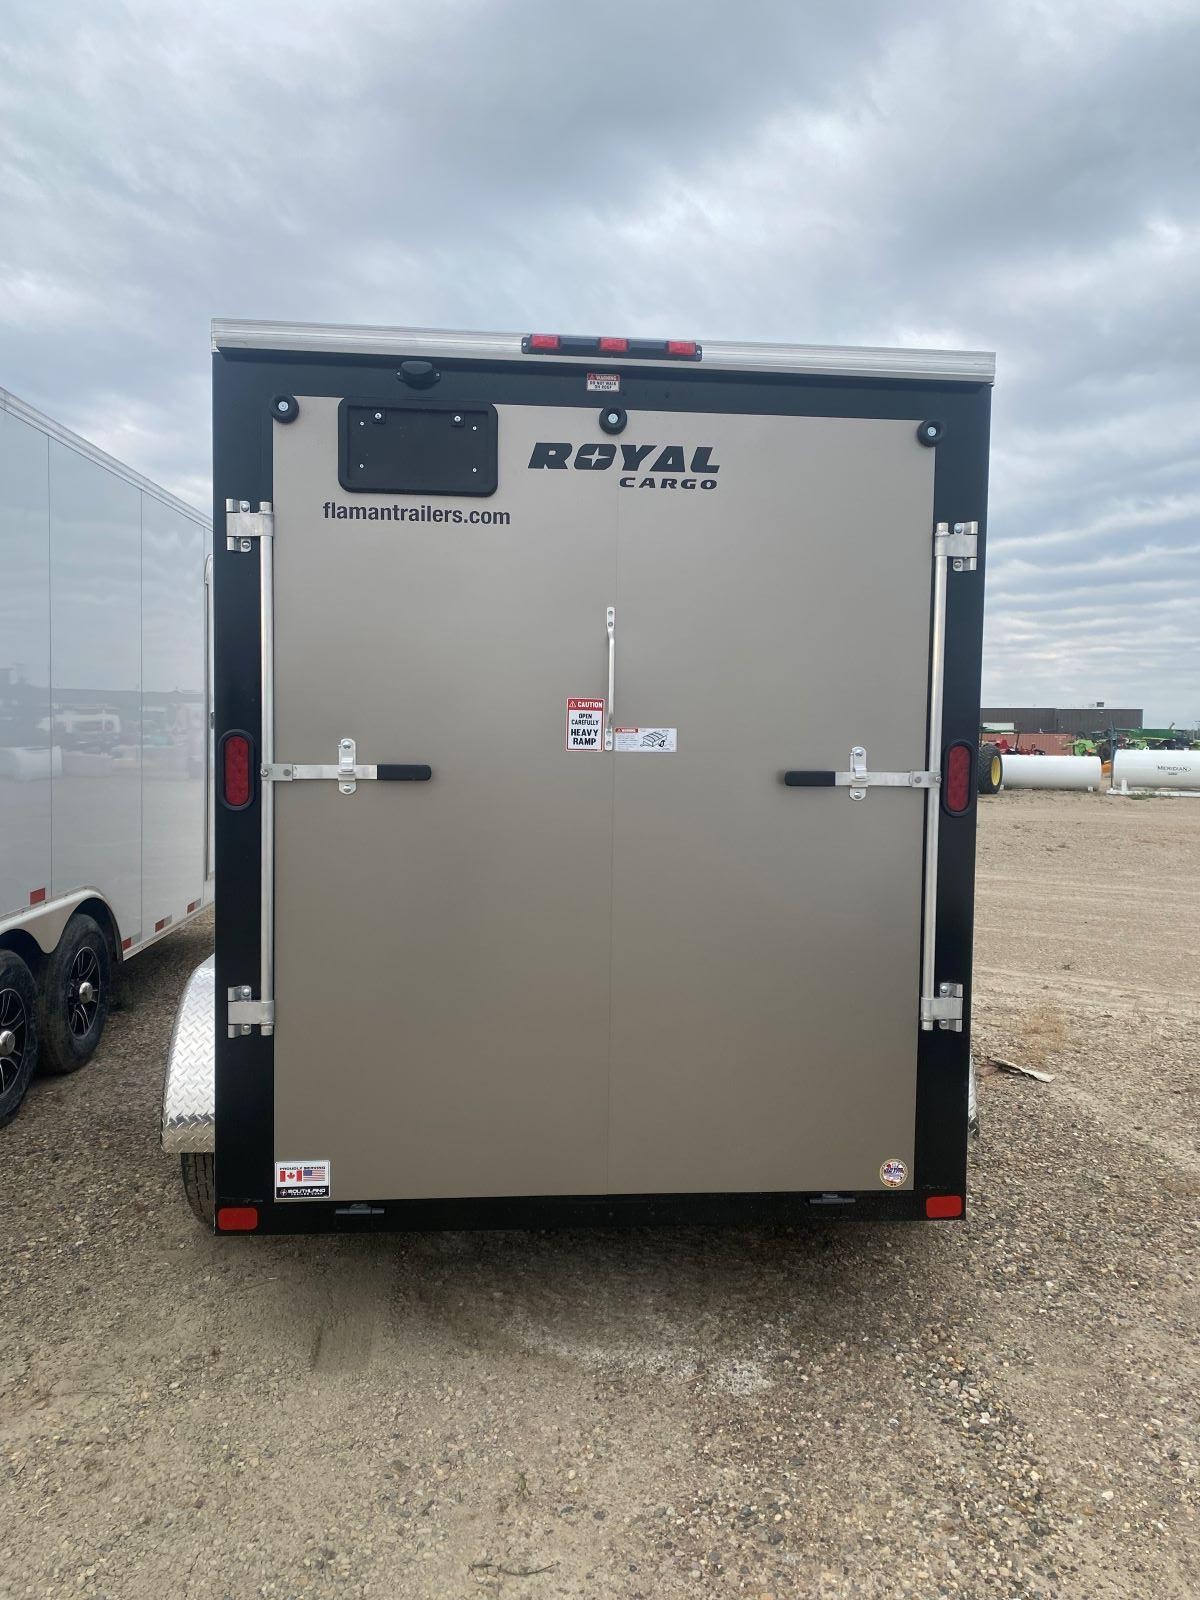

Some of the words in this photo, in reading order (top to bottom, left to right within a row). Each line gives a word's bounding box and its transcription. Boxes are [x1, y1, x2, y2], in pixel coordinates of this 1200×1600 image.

[528, 442, 720, 473] ROYAL
[619, 477, 718, 490] CARGO
[323, 502, 511, 525] flamantrailers.com
